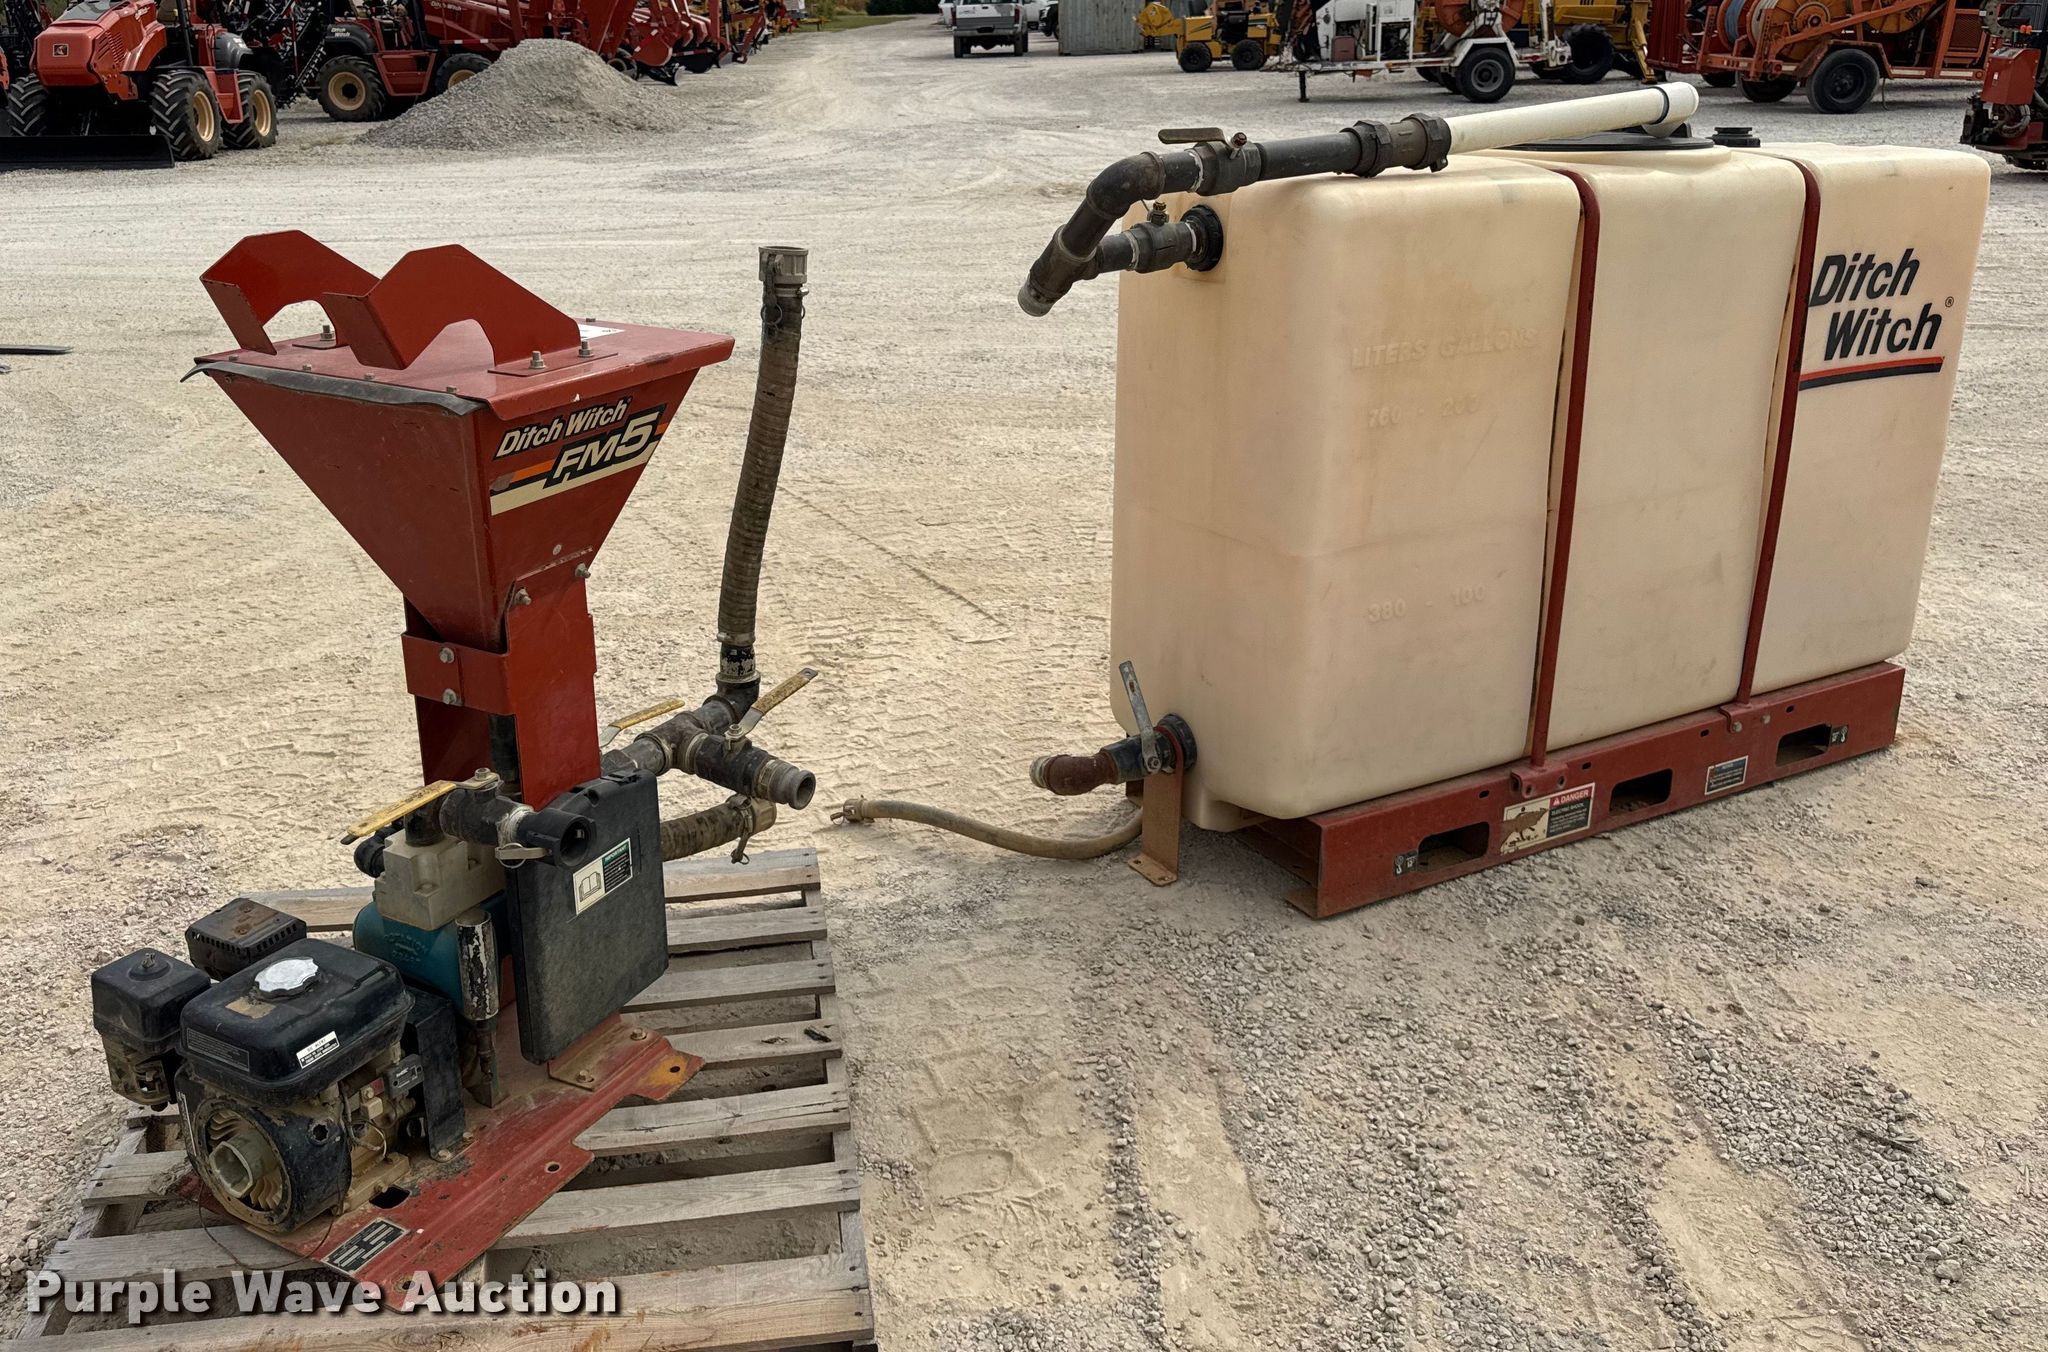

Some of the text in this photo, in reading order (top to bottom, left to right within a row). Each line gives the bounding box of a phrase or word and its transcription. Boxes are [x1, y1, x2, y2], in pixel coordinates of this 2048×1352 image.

[1808, 248, 1920, 307] Ditch
[1352, 338, 1427, 367] LITERS
[1824, 302, 1942, 361] Witch
[495, 399, 629, 458] Ditch Witch
[552, 411, 660, 479] FM5
[1560, 789, 1589, 804] DANGER
